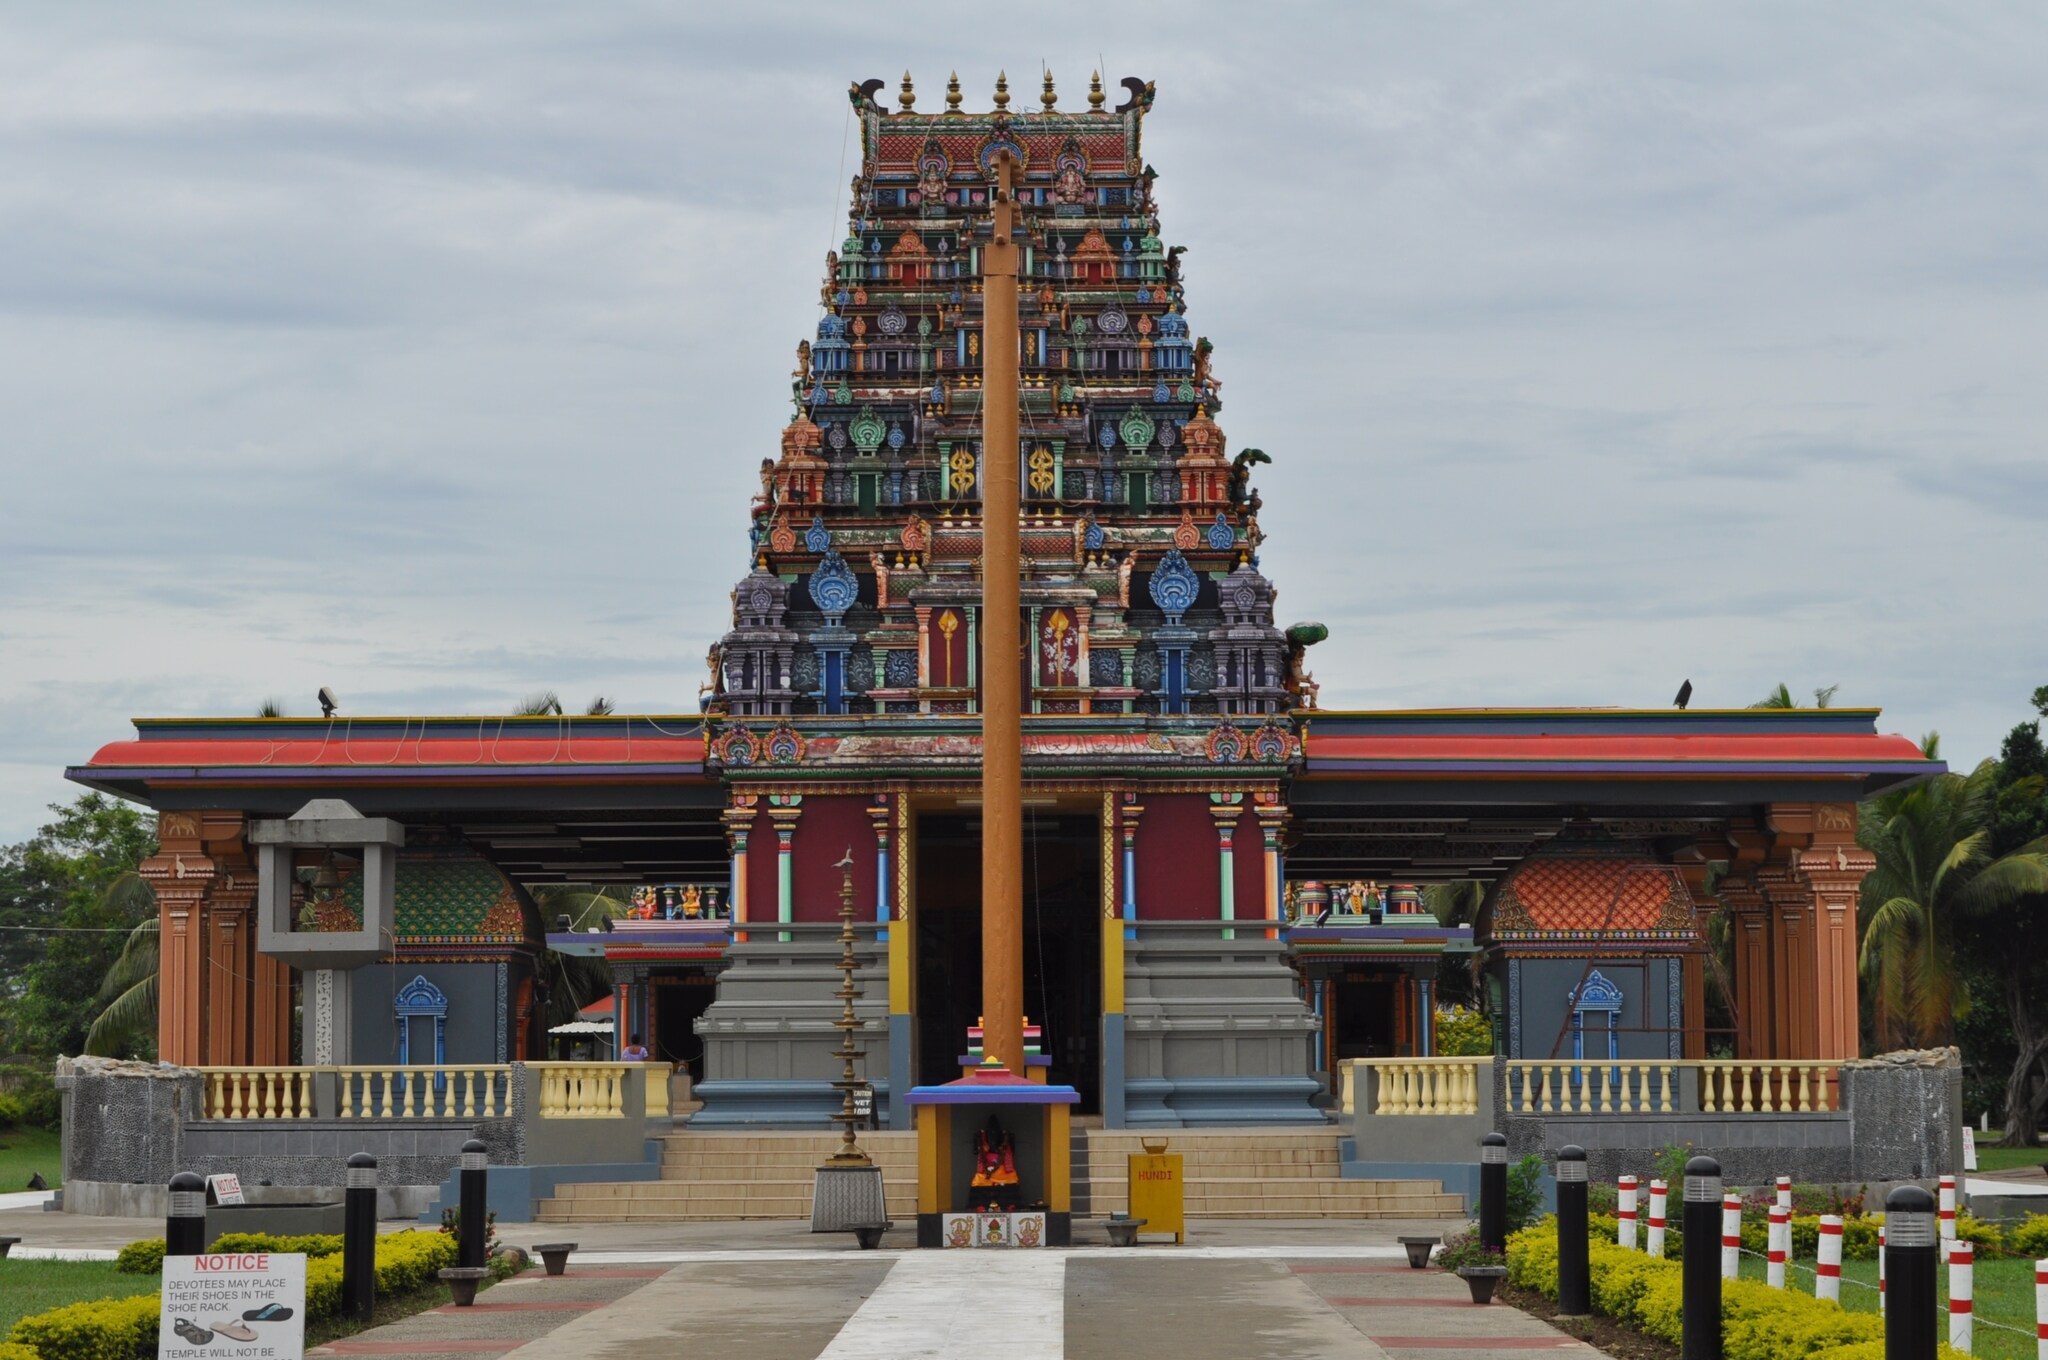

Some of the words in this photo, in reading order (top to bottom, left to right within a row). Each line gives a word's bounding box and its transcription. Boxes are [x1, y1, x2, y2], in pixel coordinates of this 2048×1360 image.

[1138, 1170, 1173, 1181] HUNDI
[216, 1178, 240, 1191] NOTICE
[194, 1254, 269, 1271] NOTICE
[168, 1279, 225, 1290] DEVOTEES
[227, 1279, 250, 1288] MAY
[252, 1278, 287, 1288] PLACE
[168, 1291, 200, 1301] THEIR
[201, 1290, 239, 1300] SHOES
[240, 1290, 252, 1300] IN
[254, 1290, 275, 1300] THE
[167, 1303, 197, 1313] SHOE
[199, 1302, 231, 1312] RACK.
[165, 1349, 207, 1359] TEMPLE
[209, 1348, 234, 1358] WILL
[236, 1347, 258, 1358] NOT
[260, 1347, 275, 1357] BE
